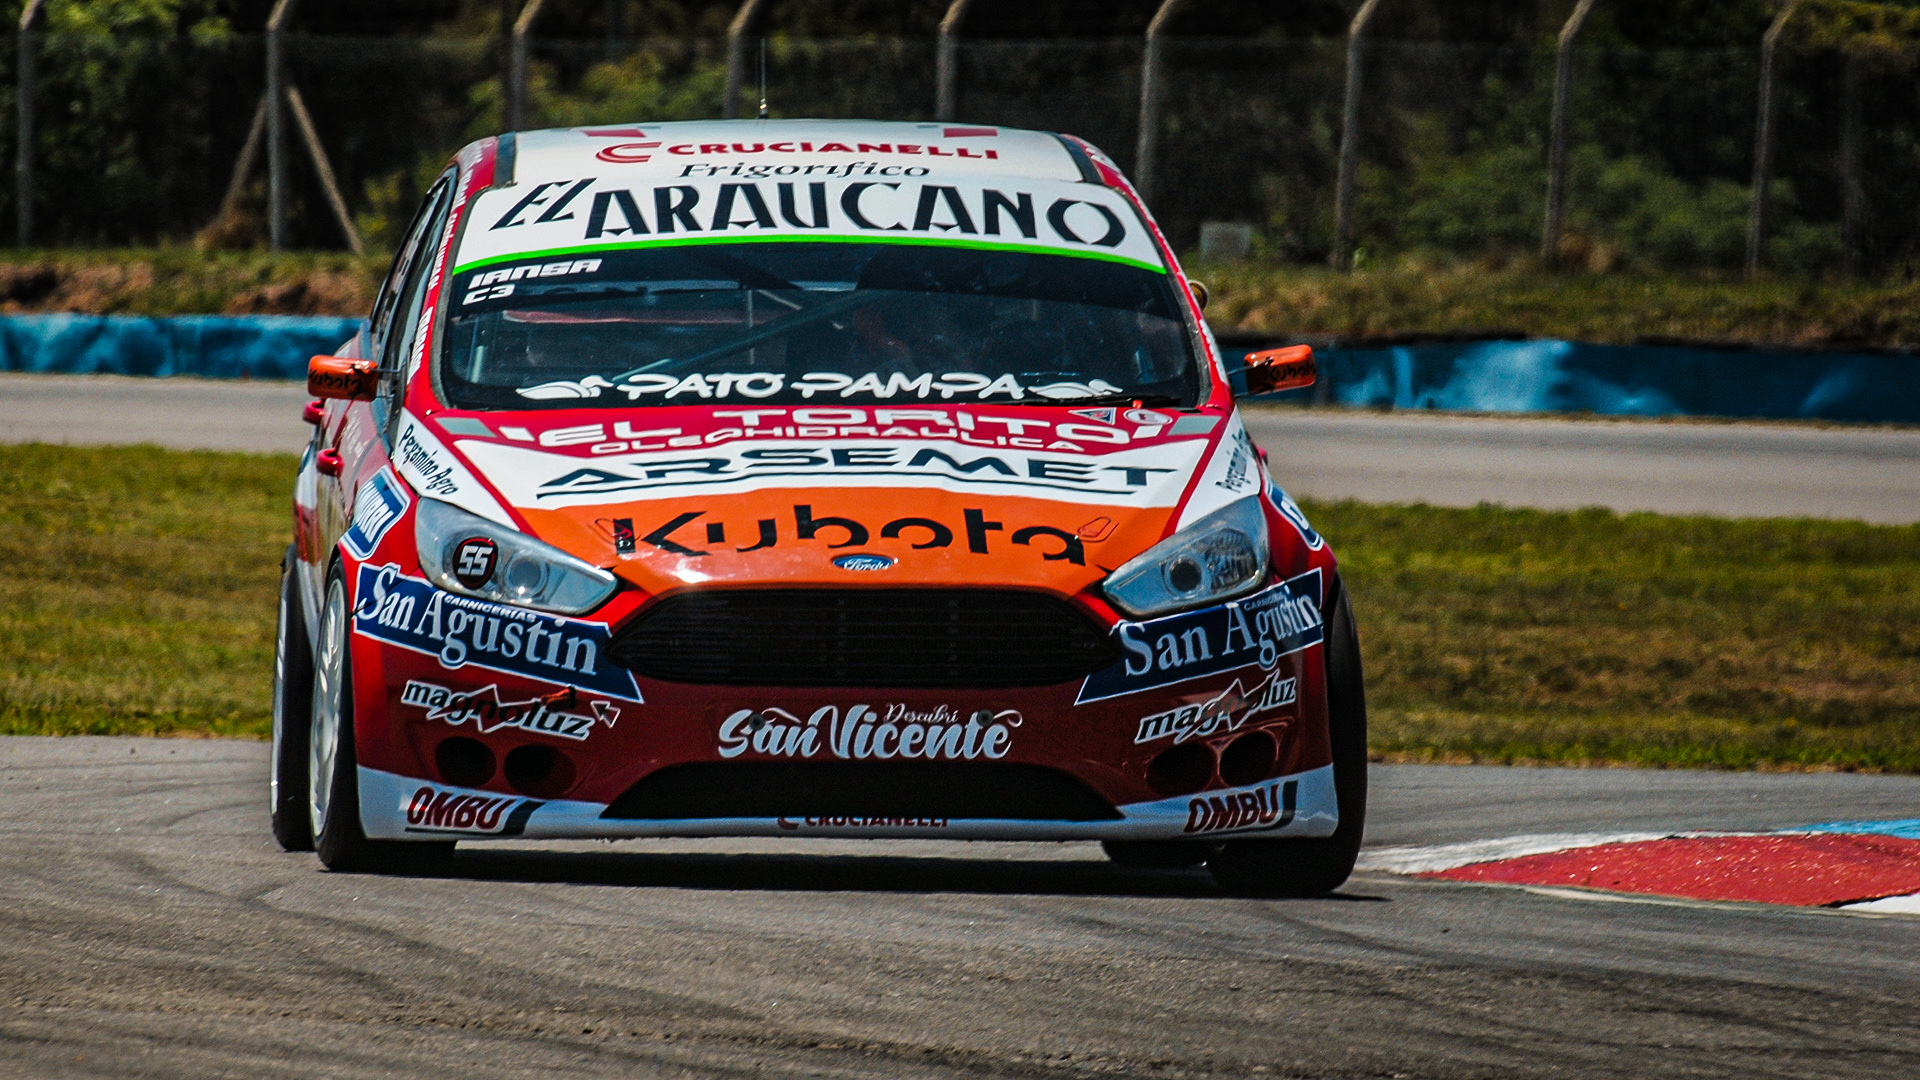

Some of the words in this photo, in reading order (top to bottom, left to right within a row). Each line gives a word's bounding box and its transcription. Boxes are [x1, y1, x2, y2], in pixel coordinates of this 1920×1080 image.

[667, 142, 998, 160] CRUCIANELLI
[488, 177, 597, 231] EL
[584, 182, 1126, 247] ARAUCANO
[462, 284, 516, 305] C3
[468, 258, 603, 290] IANSA
[616, 371, 786, 400] PATO
[791, 371, 1026, 400] PAMPA
[538, 420, 682, 447] EL
[712, 407, 1131, 445] TORITO
[426, 466, 459, 495] Agro
[535, 447, 1180, 492] ARSEMET
[612, 504, 1086, 566] Kubota
[843, 558, 890, 571] Ford
[354, 564, 415, 630] San
[414, 590, 598, 676] Agustin
[444, 594, 537, 623] CARNICERIAS
[1118, 621, 1214, 677] San
[403, 681, 595, 738] magnoluz
[1136, 670, 1296, 742] magnoluz
[718, 706, 822, 759] San
[807, 703, 1023, 760] Vicente
[406, 785, 513, 830] OMBU
[1183, 781, 1280, 834] OMBU
